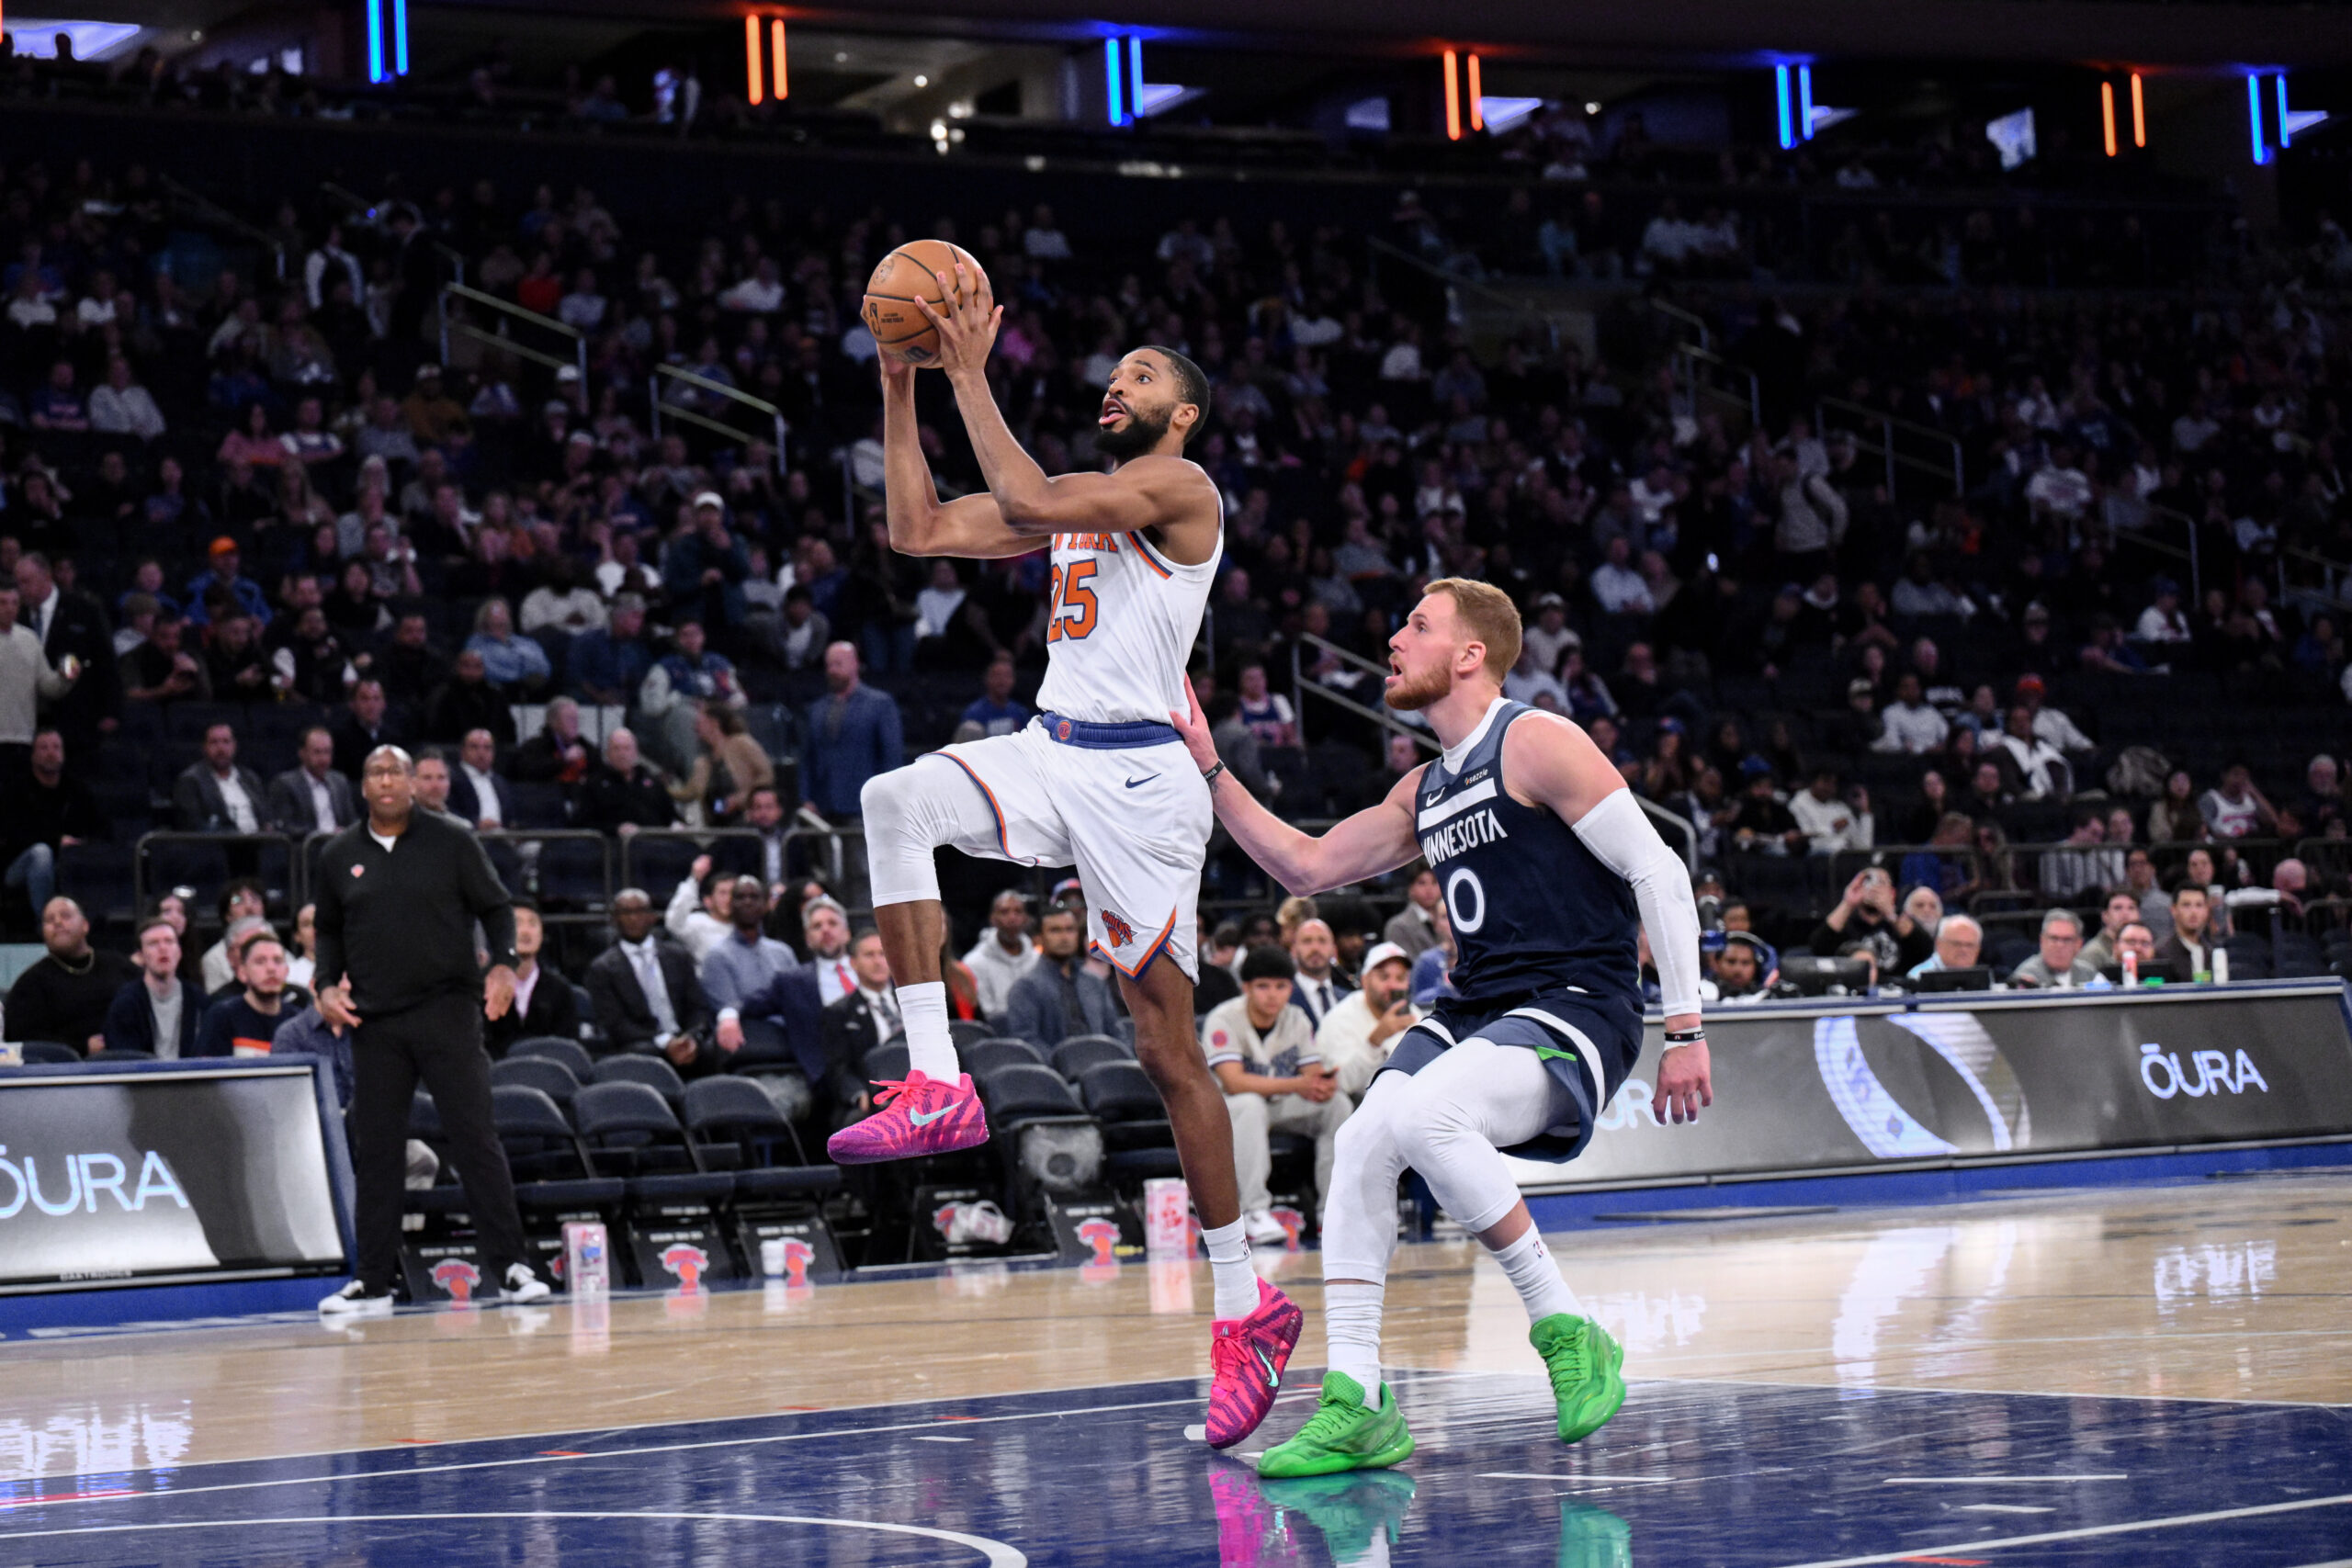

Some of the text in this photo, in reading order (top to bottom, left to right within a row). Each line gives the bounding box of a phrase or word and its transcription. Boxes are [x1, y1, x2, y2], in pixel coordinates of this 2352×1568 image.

[1047, 558, 1098, 644] 25
[1469, 768, 1488, 784] sezzle
[1447, 866, 1486, 933] 0
[2140, 1043, 2269, 1100] ŌURA
